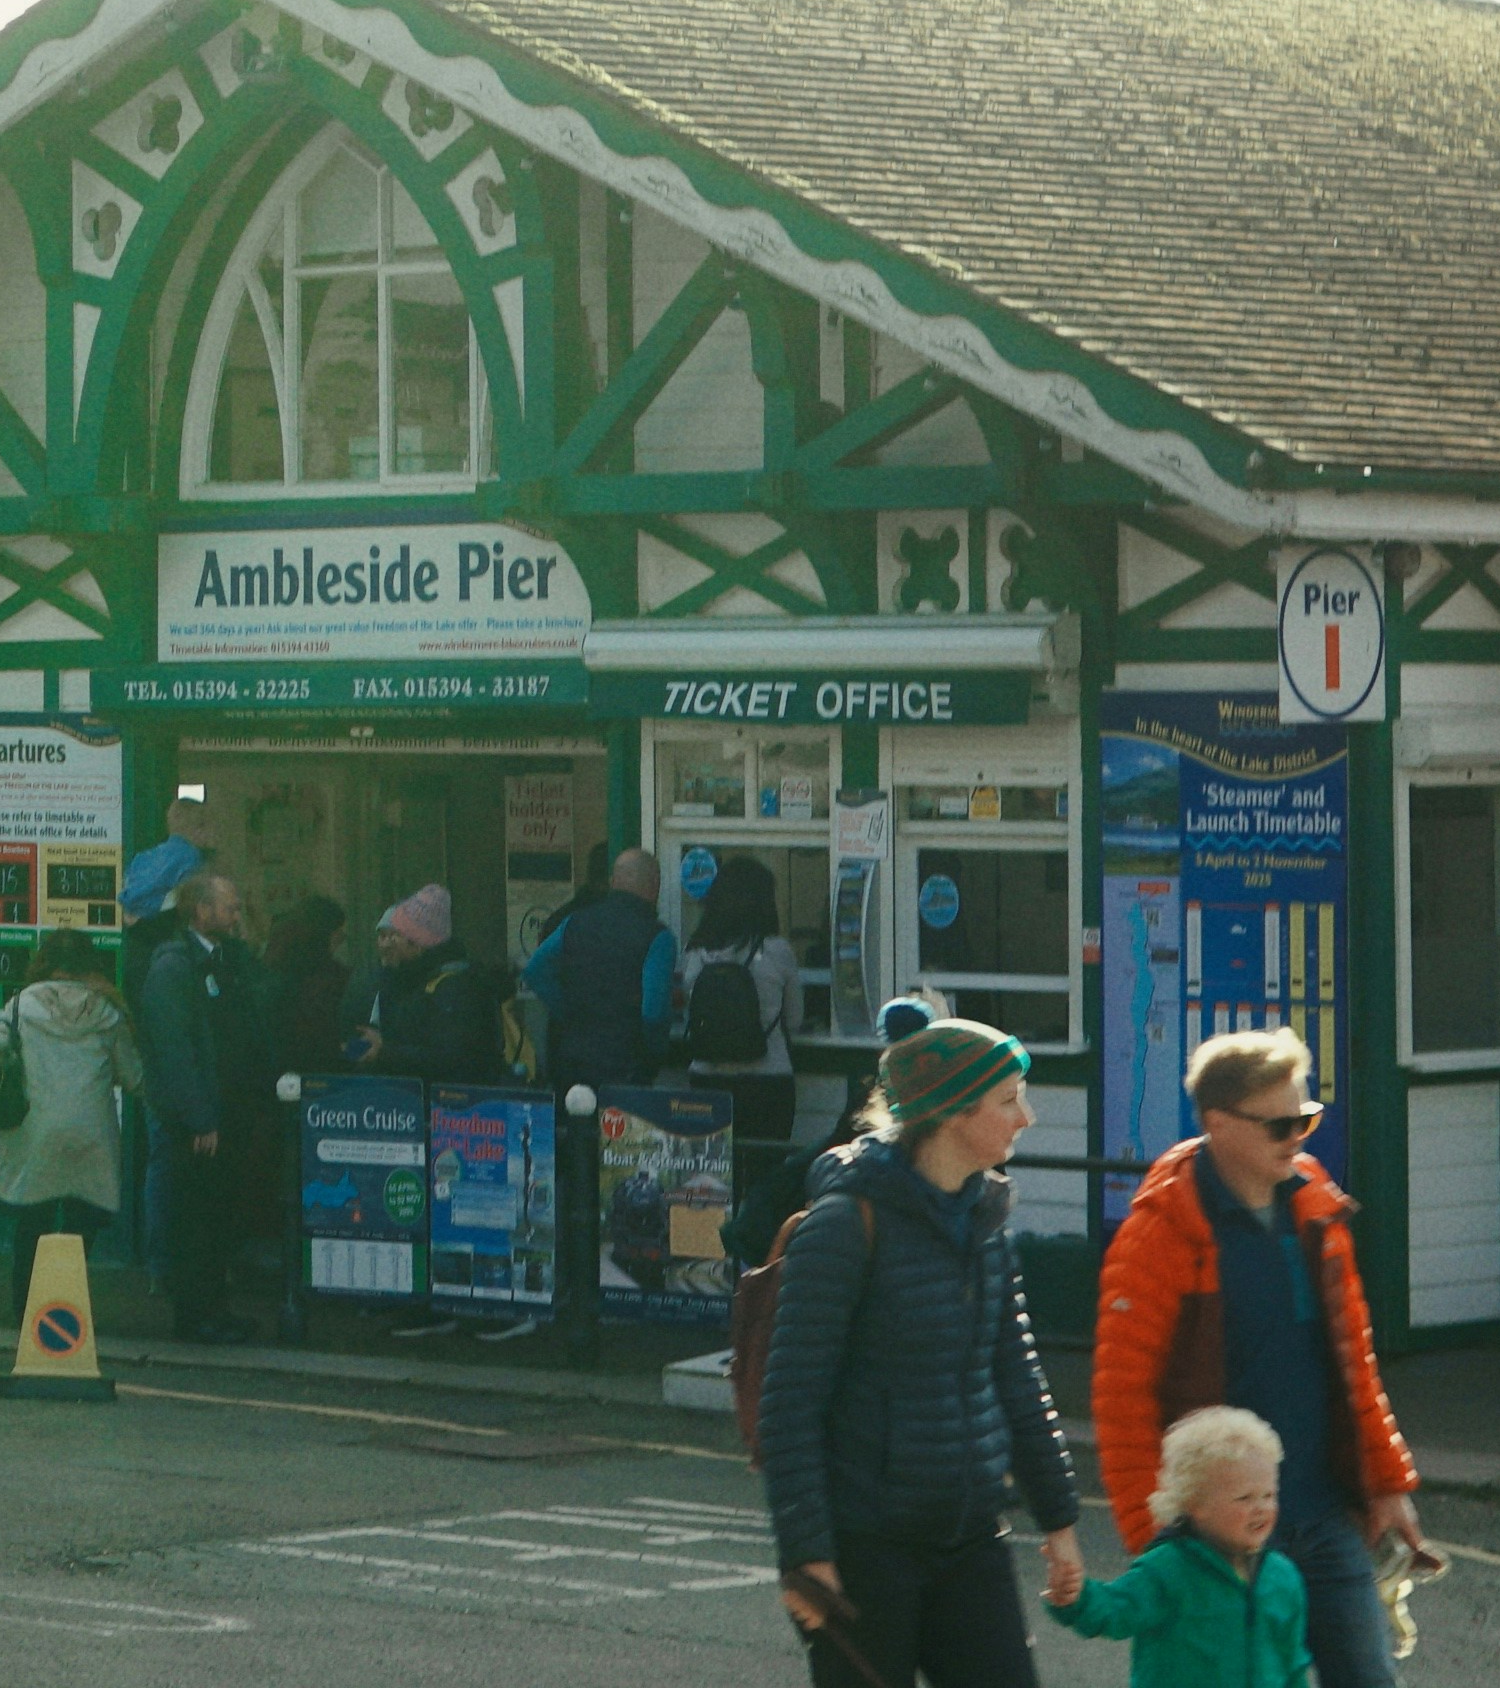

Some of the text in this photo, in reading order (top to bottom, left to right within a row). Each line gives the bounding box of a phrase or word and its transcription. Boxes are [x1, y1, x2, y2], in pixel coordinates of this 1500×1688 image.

[194, 540, 557, 608] Ambleside Pier
[1304, 582, 1361, 616] Pier
[217, 623, 236, 638] days
[325, 622, 346, 636] great
[435, 619, 457, 631] Lake
[124, 680, 168, 701] TEL.
[172, 679, 238, 701] 015394
[255, 678, 310, 700] 32225
[353, 677, 398, 698] FAX.
[404, 676, 473, 698] 015394
[492, 674, 550, 698] 33187
[664, 681, 953, 720] TICKET OFFICE
[1136, 716, 1147, 732] In
[1150, 720, 1169, 737] the
[1172, 726, 1201, 751] heart
[1203, 743, 1218, 760] of
[1219, 749, 1237, 768] the
[1241, 754, 1269, 771] Lake
[1273, 747, 1318, 771] District
[1202, 783, 1325, 807] 'Steamer' and
[12, 810, 31, 823] refer
[33, 811, 43, 823] to
[45, 810, 84, 824] timetable
[86, 814, 96, 824] or
[1186, 808, 1341, 834] Launch Timetable
[0, 825, 12, 836] the
[14, 824, 37, 837] ticket
[39, 825, 63, 838] office
[65, 825, 76, 837] for
[79, 825, 108, 838] details
[1203, 852, 1235, 869] April
[1263, 853, 1327, 870] November
[307, 1103, 416, 1132] Green Cruise
[431, 1108, 506, 1137] Freedom
[463, 1138, 506, 1161] Lake
[603, 1148, 635, 1166] Boat
[696, 1154, 731, 1172] Train
